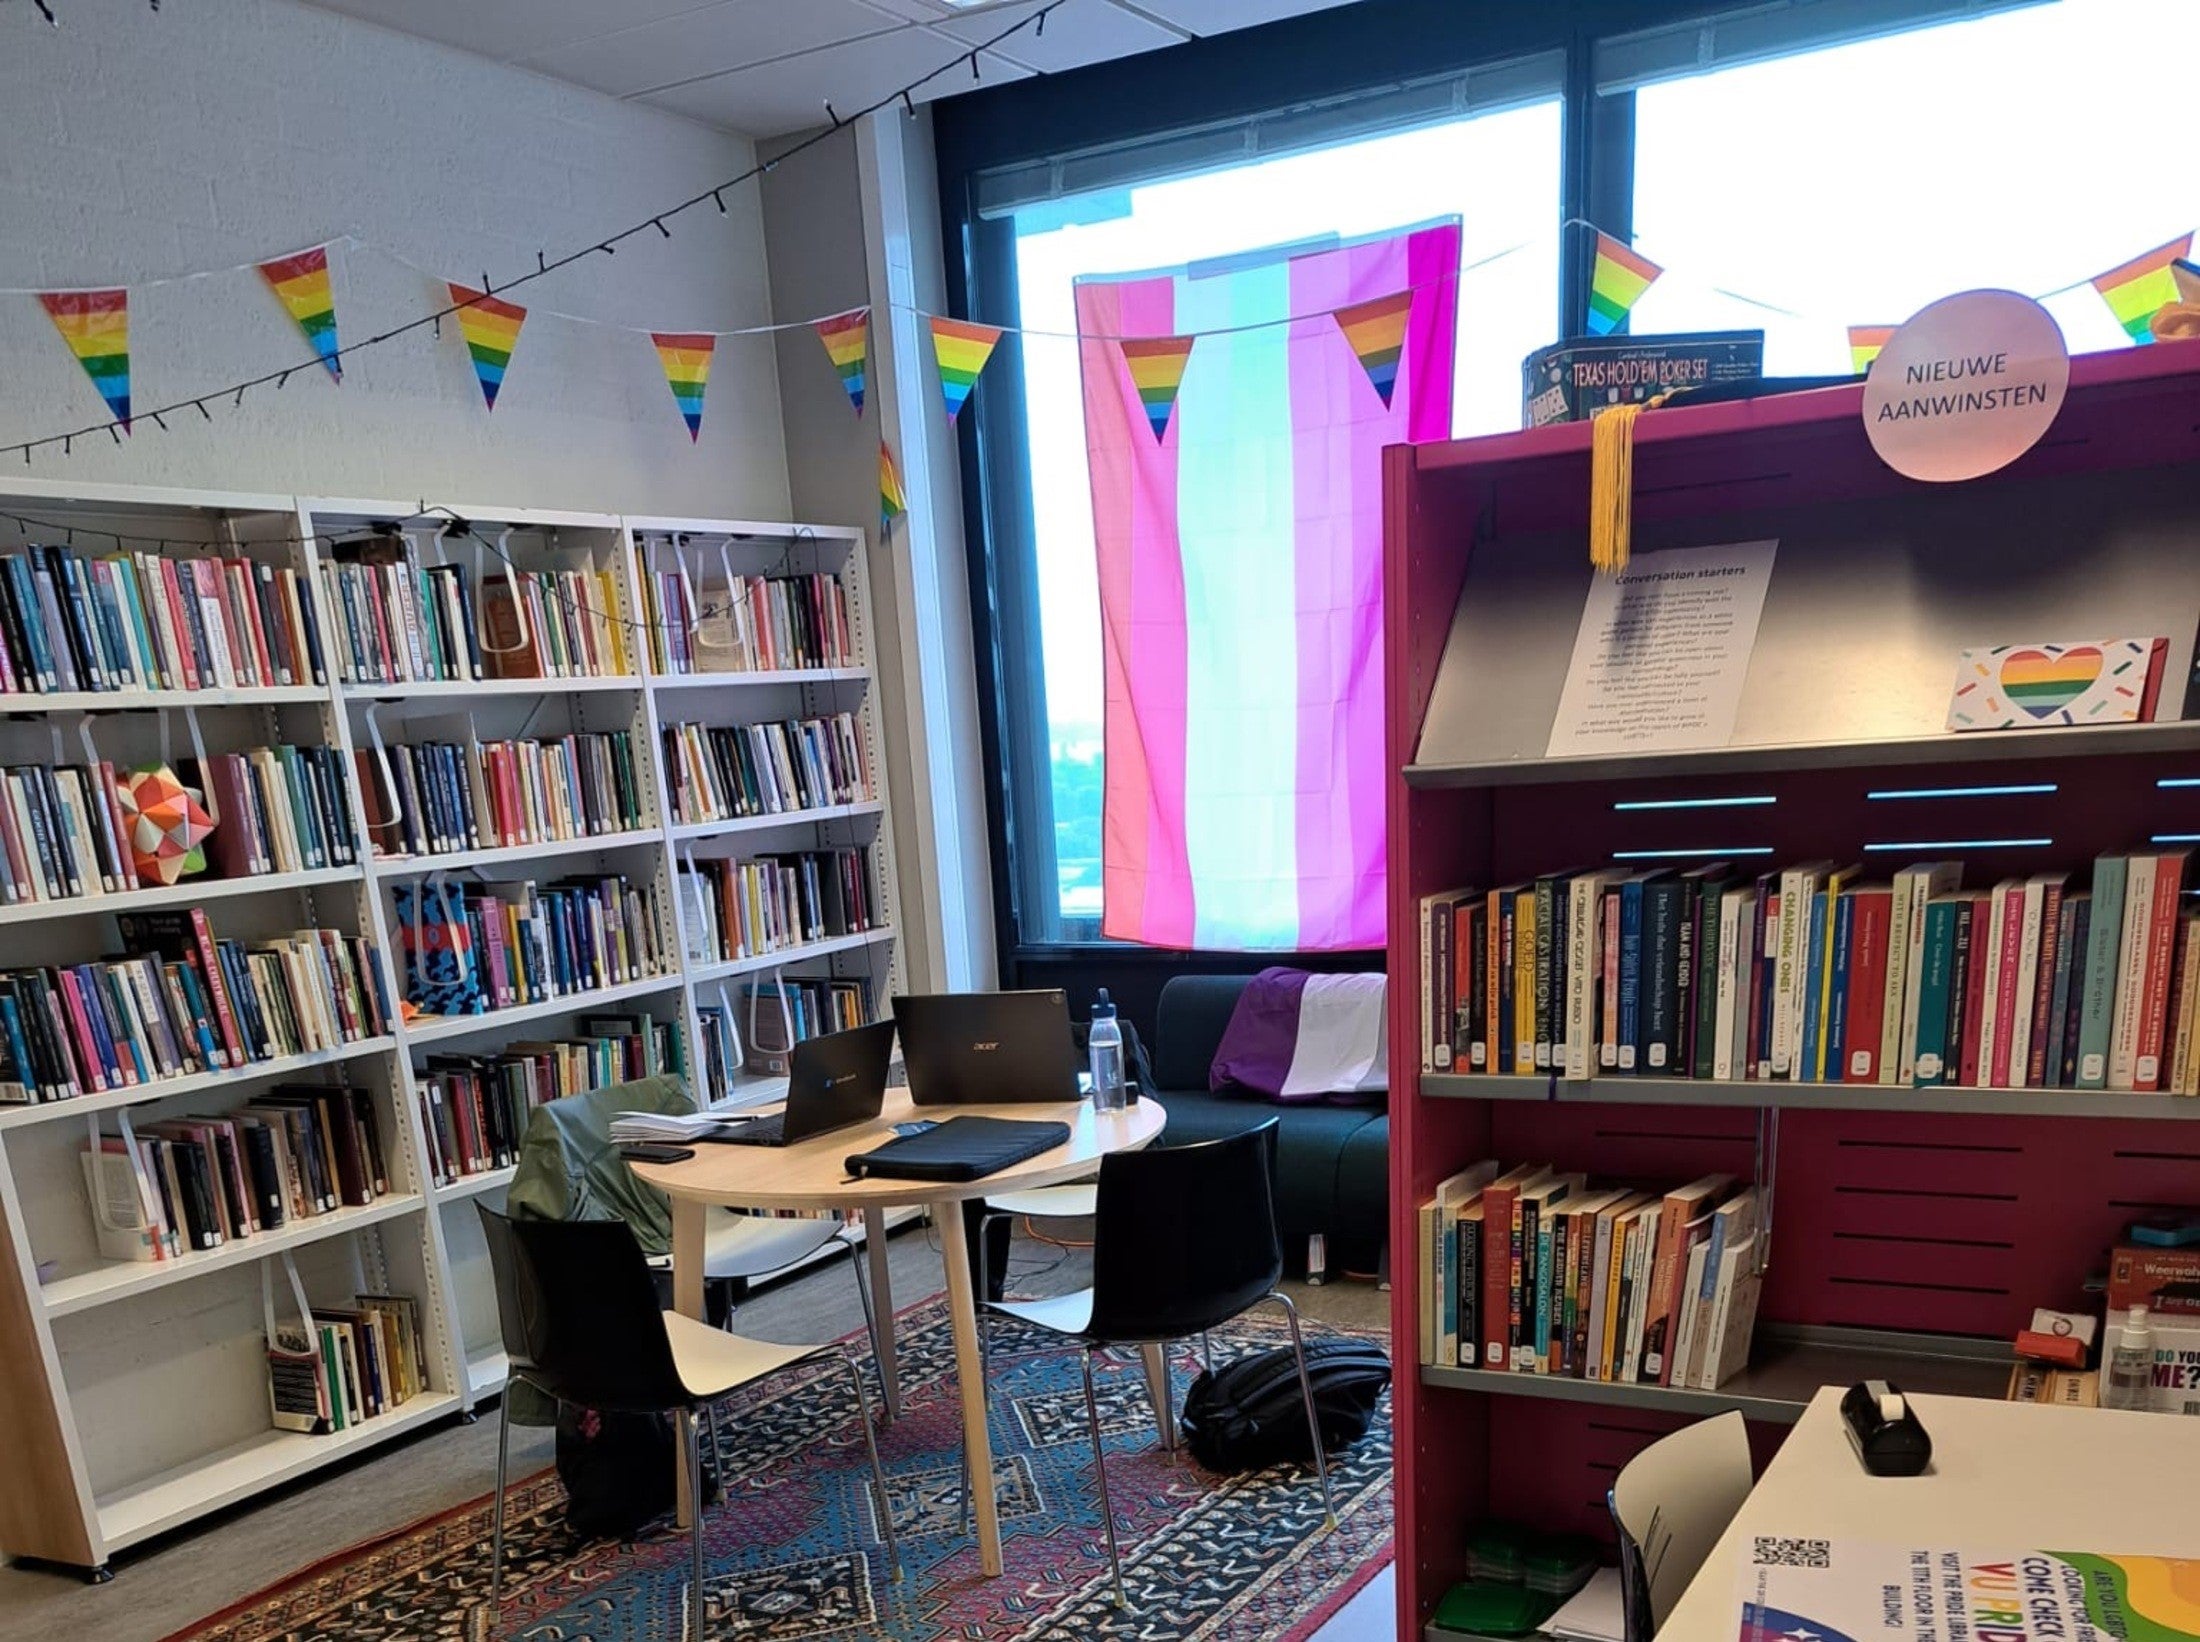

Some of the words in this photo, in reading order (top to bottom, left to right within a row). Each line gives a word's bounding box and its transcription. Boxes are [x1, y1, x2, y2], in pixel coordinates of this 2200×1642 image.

[1572, 362, 1606, 388] TEXAS
[1658, 359, 1692, 384] POKER
[1692, 358, 1708, 381] SET
[1905, 352, 2009, 386] NIEUWE
[1877, 381, 2048, 423] AANWINSTEN
[1615, 570, 1695, 586] Conversation
[1696, 565, 1746, 580] starters
[1781, 892, 1797, 959] CHANGING
[1892, 923, 1904, 962] RESPECT
[1536, 934, 1550, 1008] CASTRATION
[1779, 962, 1793, 994] ONES
[2154, 1348, 2176, 1364] DO
[1910, 1550, 1930, 1565] THE
[1940, 1551, 1962, 1572] VISIT
[1911, 1566, 1932, 1583] 11TH
[1943, 1573, 1962, 1588] THE
[1970, 1562, 2018, 1592] VU
[2022, 1557, 2055, 1594] COME
[2061, 1564, 2088, 1605] LOOKING
[2093, 1570, 2114, 1587] ARE
[1882, 1584, 1905, 1629] BUILDING!
[1913, 1585, 1935, 1615] FLOOR
[1945, 1589, 1965, 1615] PRIDE
[2099, 1588, 2118, 1608] YOU
[1916, 1616, 1936, 1627] IN
[2029, 1597, 2065, 1638] CHECK
[2072, 1607, 2094, 1624] FOR
